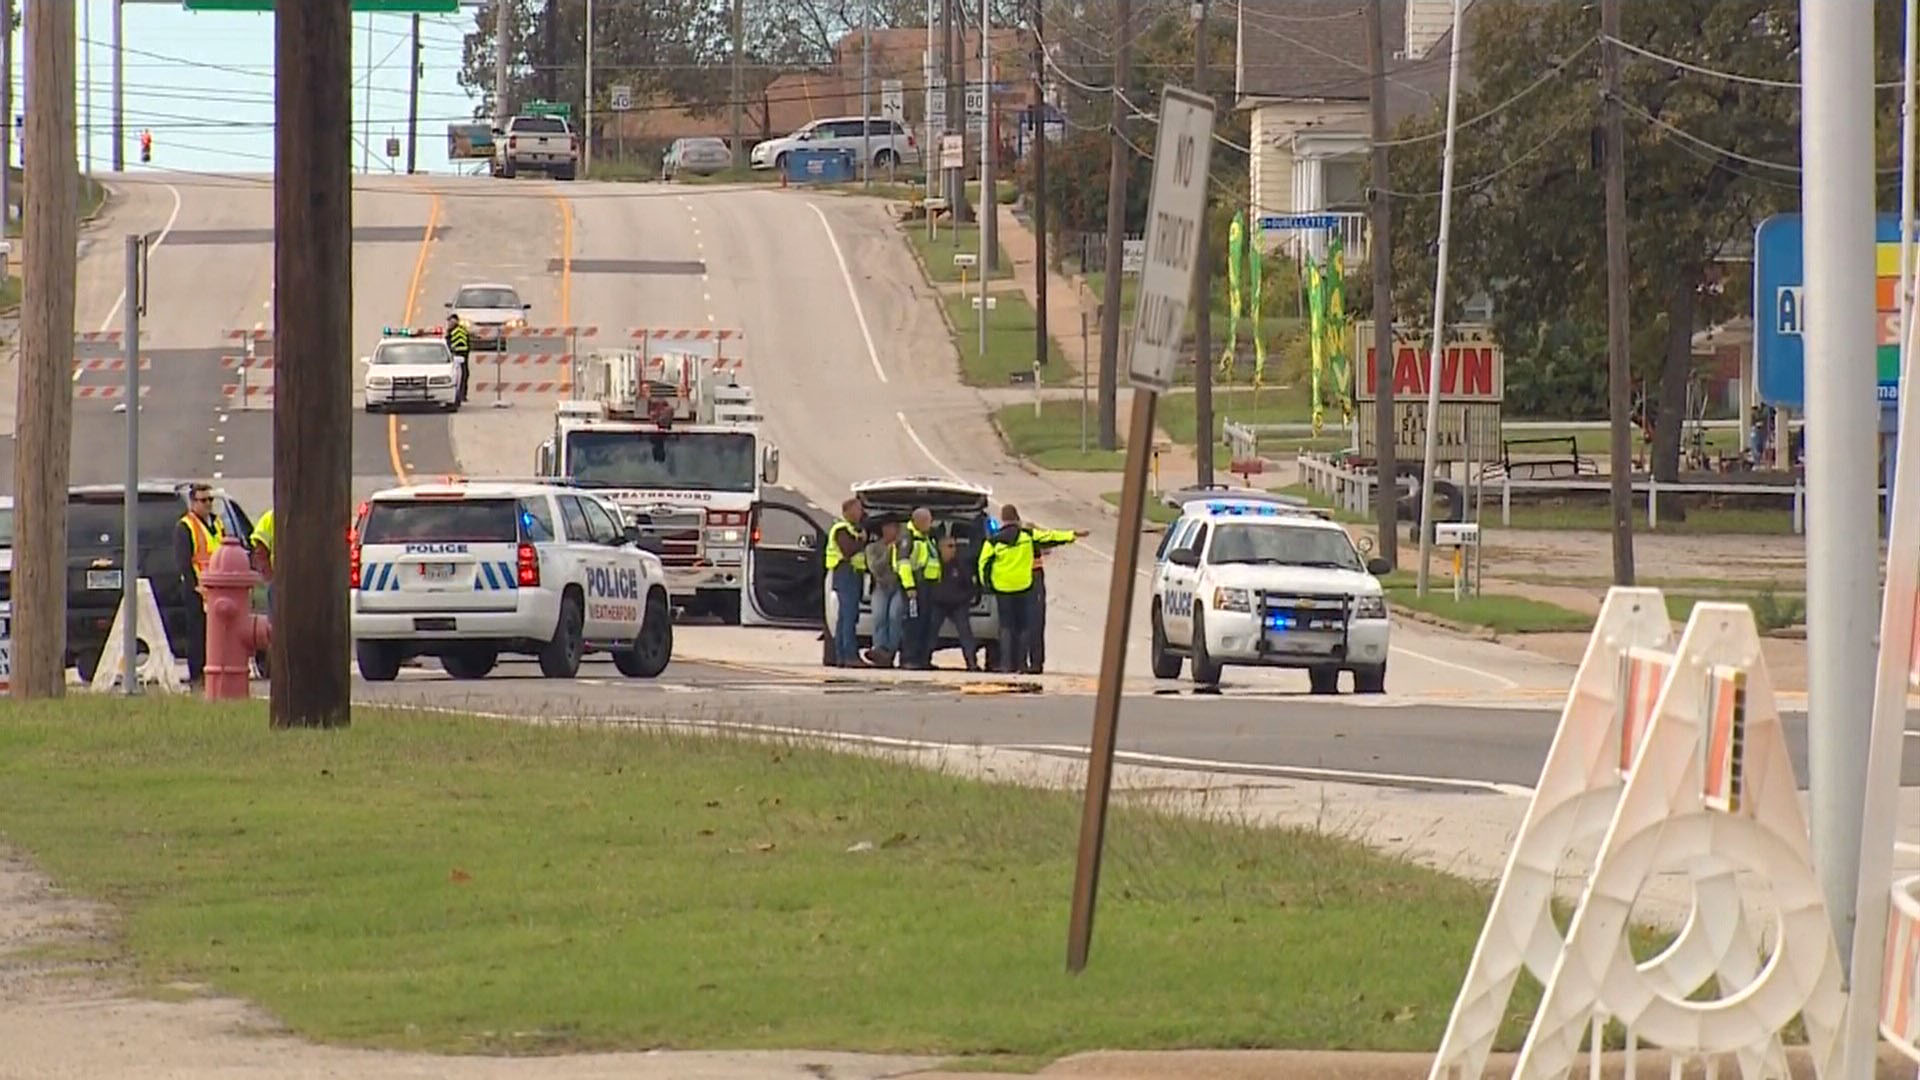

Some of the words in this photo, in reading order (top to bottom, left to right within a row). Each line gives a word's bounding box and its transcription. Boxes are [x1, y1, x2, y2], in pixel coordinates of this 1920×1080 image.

[1172, 134, 1195, 188] NO
[406, 544, 468, 554] POLICE
[586, 567, 638, 599] POLICE
[1164, 590, 1192, 617] POLICE
